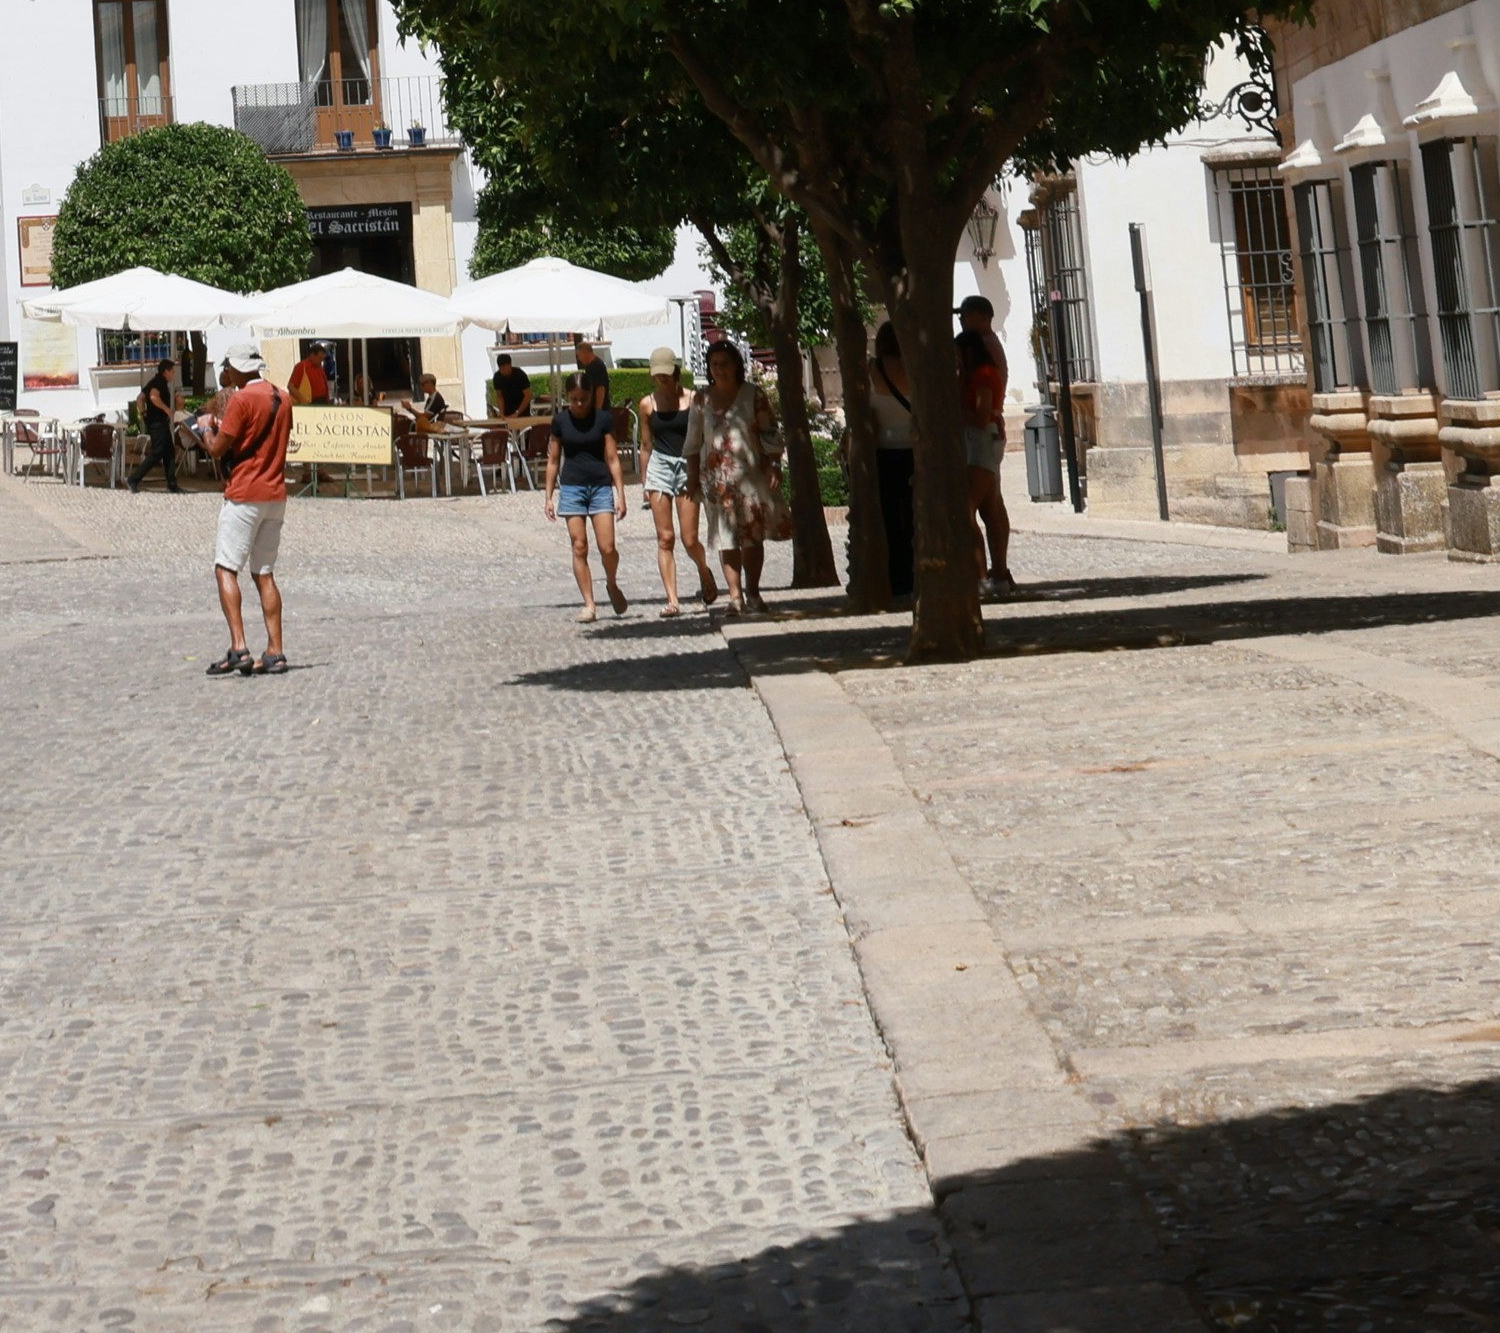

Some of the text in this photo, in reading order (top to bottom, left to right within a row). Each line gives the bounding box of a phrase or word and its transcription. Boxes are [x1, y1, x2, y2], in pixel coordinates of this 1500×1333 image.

[305, 209, 358, 219] Restaurante
[367, 207, 398, 218] Mesón
[308, 217, 400, 235] El Sacristán
[276, 327, 316, 337] Alhambra
[322, 412, 364, 421] MESÓN
[315, 423, 390, 437] SACRISTÁN
